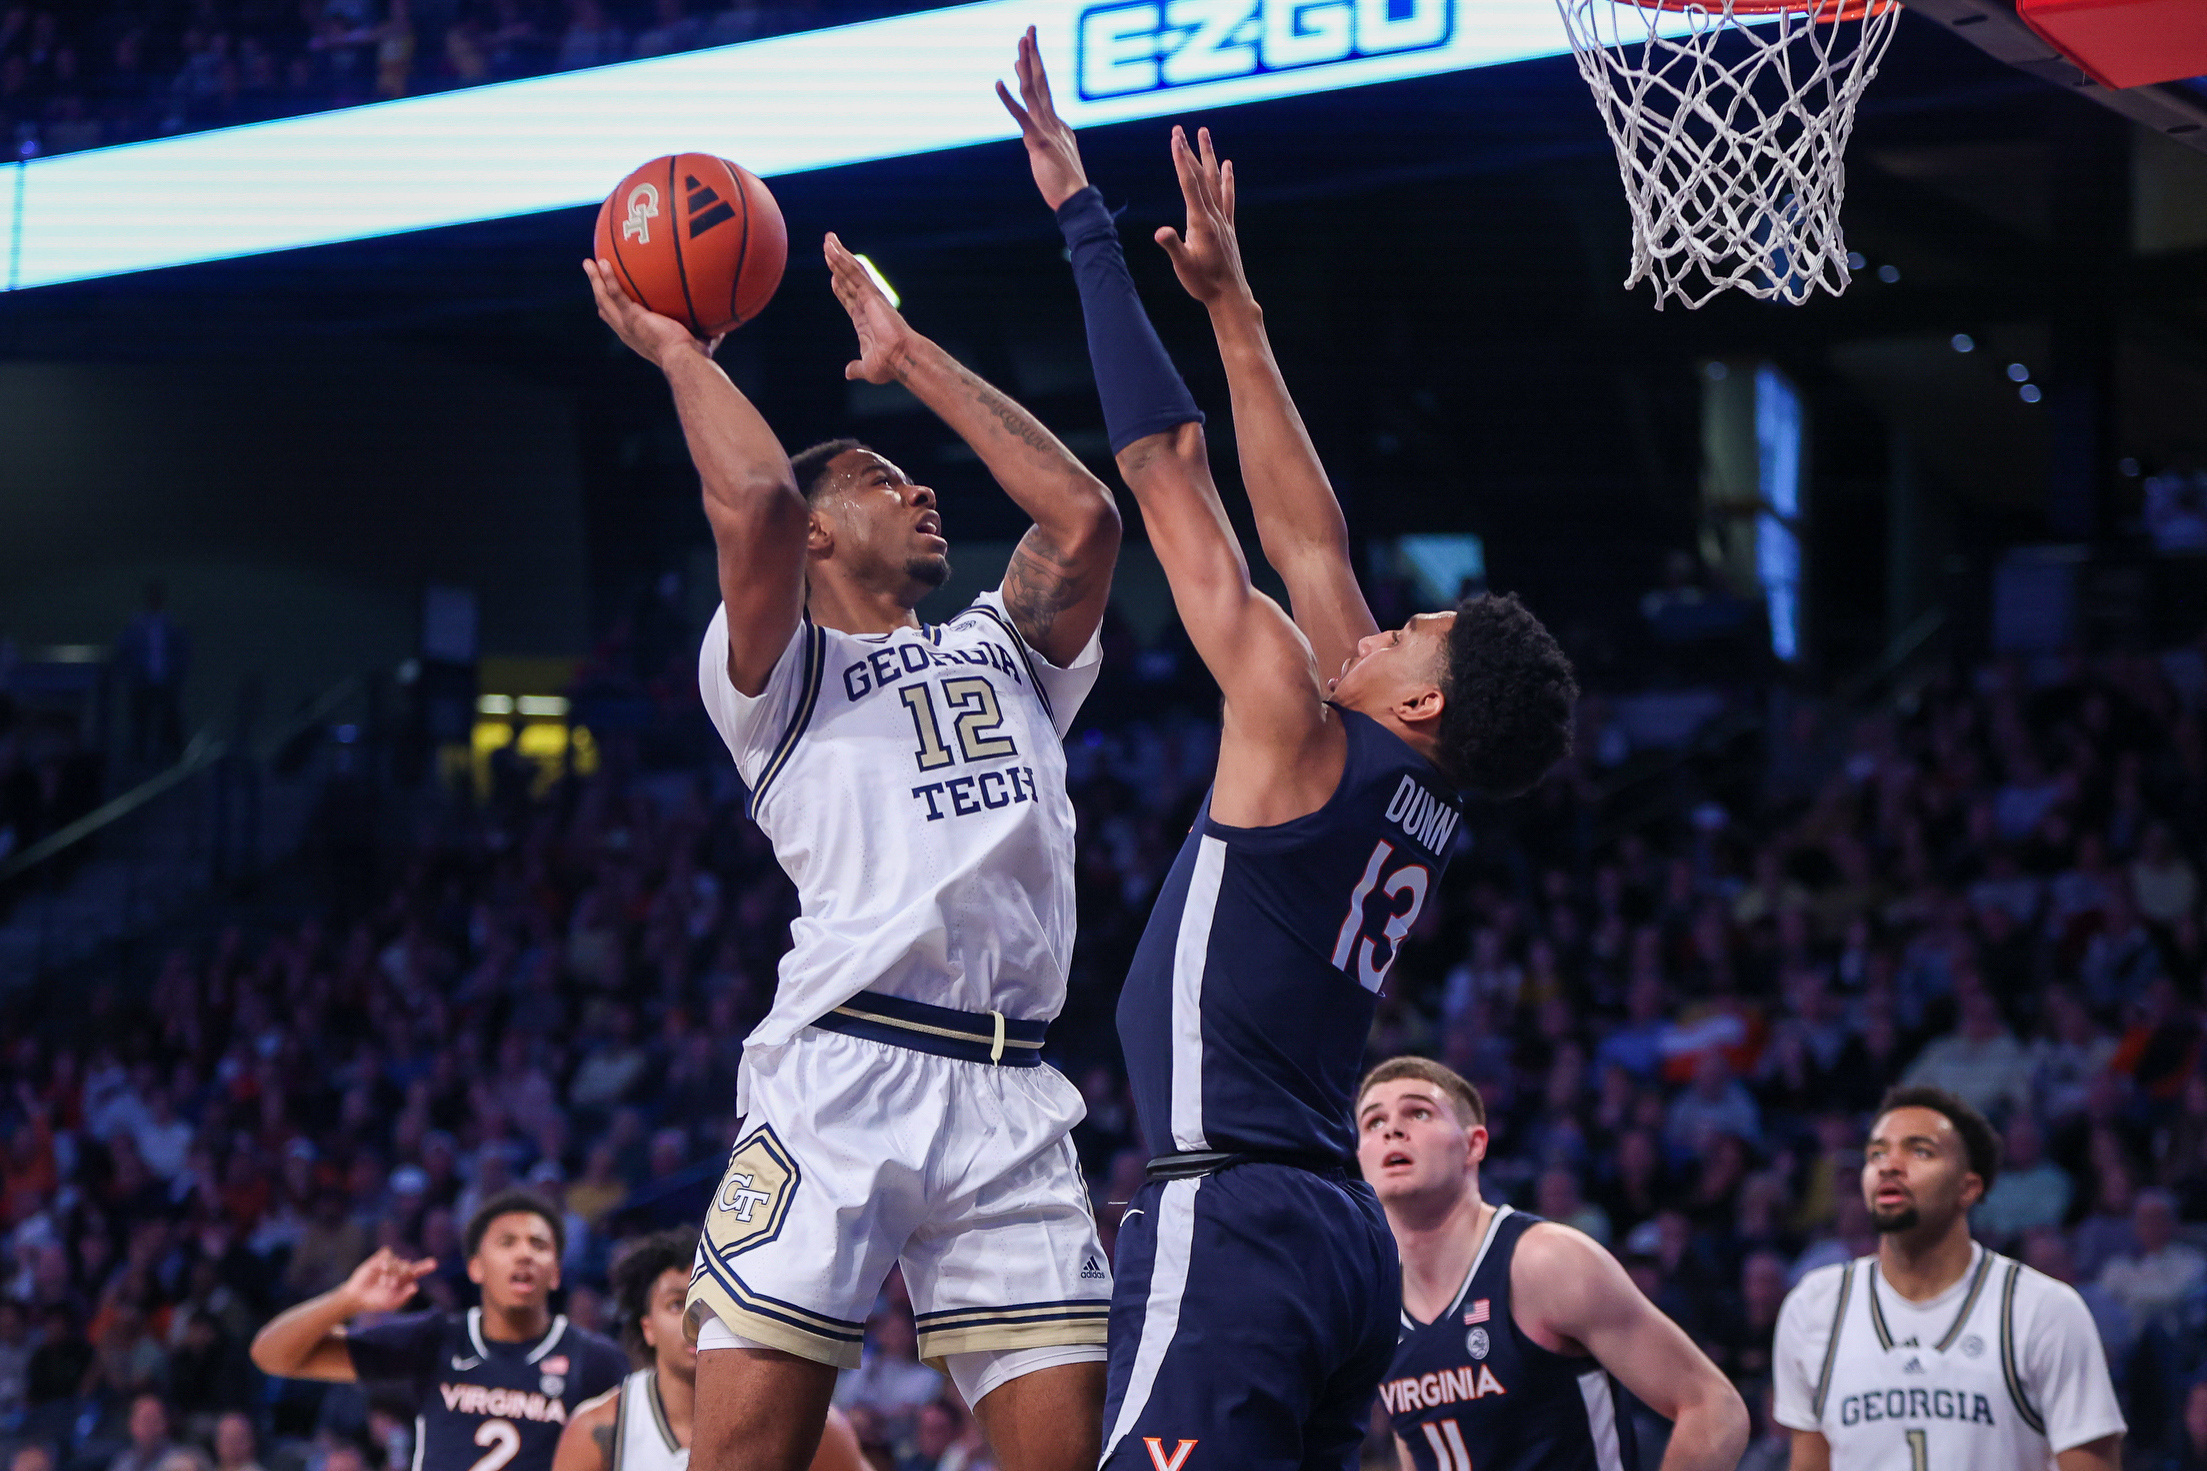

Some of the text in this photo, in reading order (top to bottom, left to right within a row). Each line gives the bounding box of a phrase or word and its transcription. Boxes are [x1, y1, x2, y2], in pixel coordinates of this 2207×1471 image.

[898, 675, 1019, 773] 12
[911, 766, 1039, 822] TECH
[1385, 774, 1459, 857] DUNN
[1330, 838, 1429, 994] 13
[718, 1172, 771, 1223] GT
[1080, 1271, 1106, 1279] adidas
[439, 1381, 567, 1426] VIRGINIA
[1378, 1363, 1507, 1416] VIRGINIA
[1841, 1388, 1995, 1427] GEORGIA
[468, 1418, 521, 1471] 2
[1421, 1418, 1472, 1471] 11
